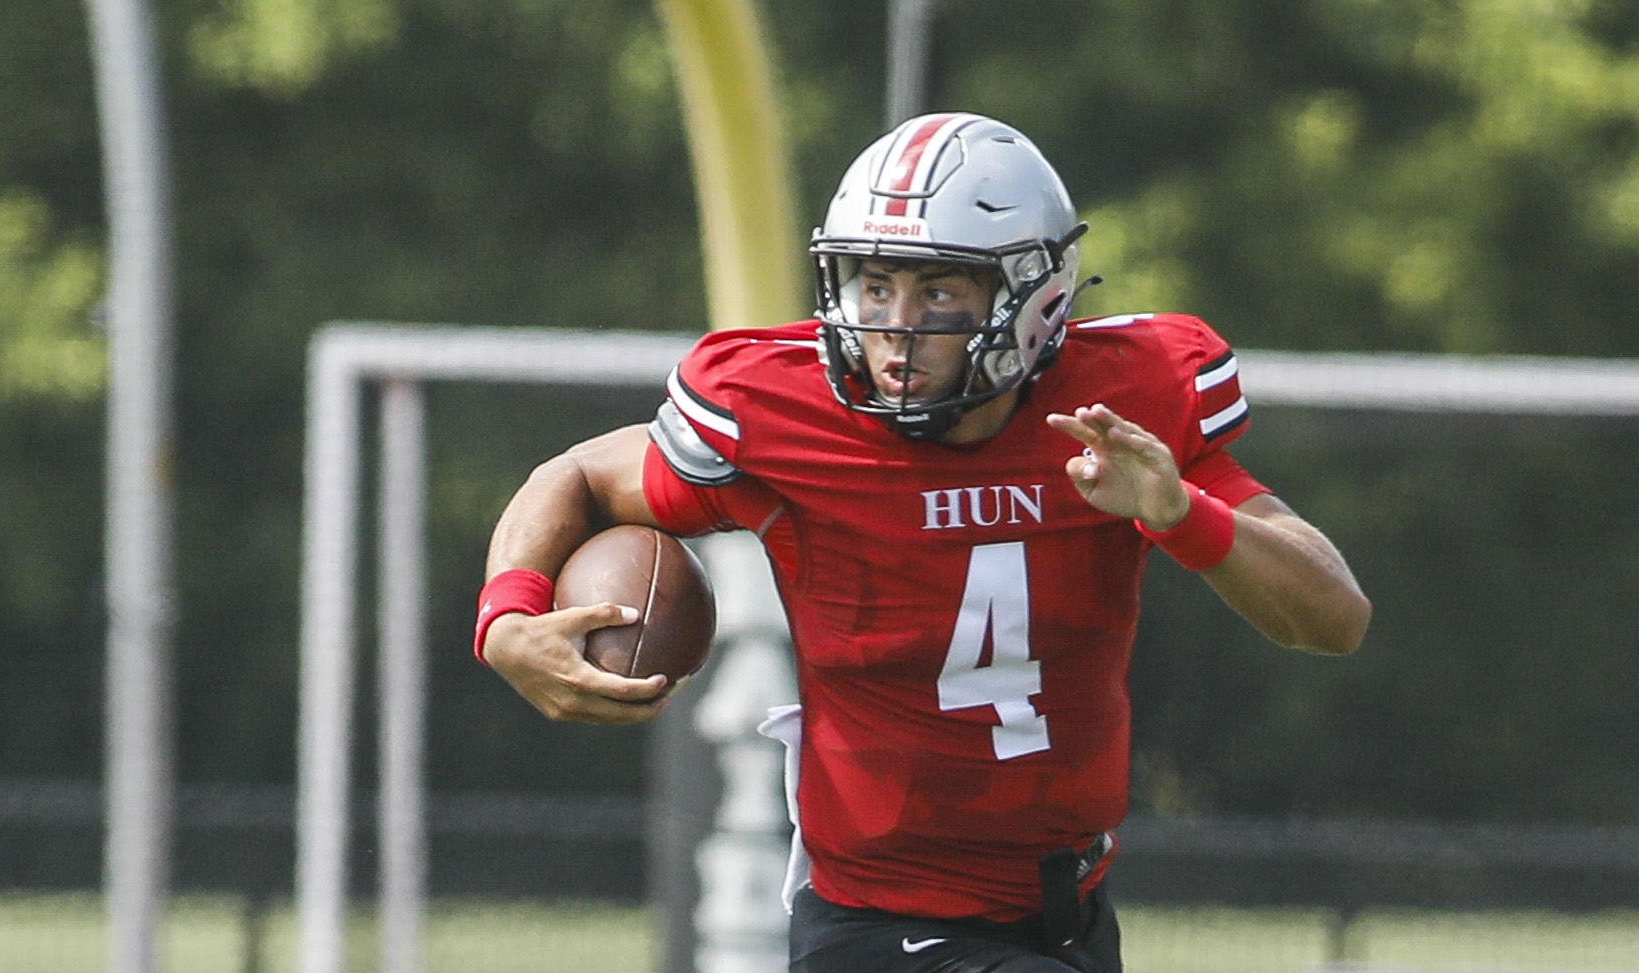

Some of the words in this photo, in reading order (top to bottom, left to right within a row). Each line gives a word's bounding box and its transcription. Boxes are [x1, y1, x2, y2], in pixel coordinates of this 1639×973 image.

[864, 221, 921, 236] Riddell
[921, 484, 1045, 530] HUN
[937, 540, 1052, 761] 4
